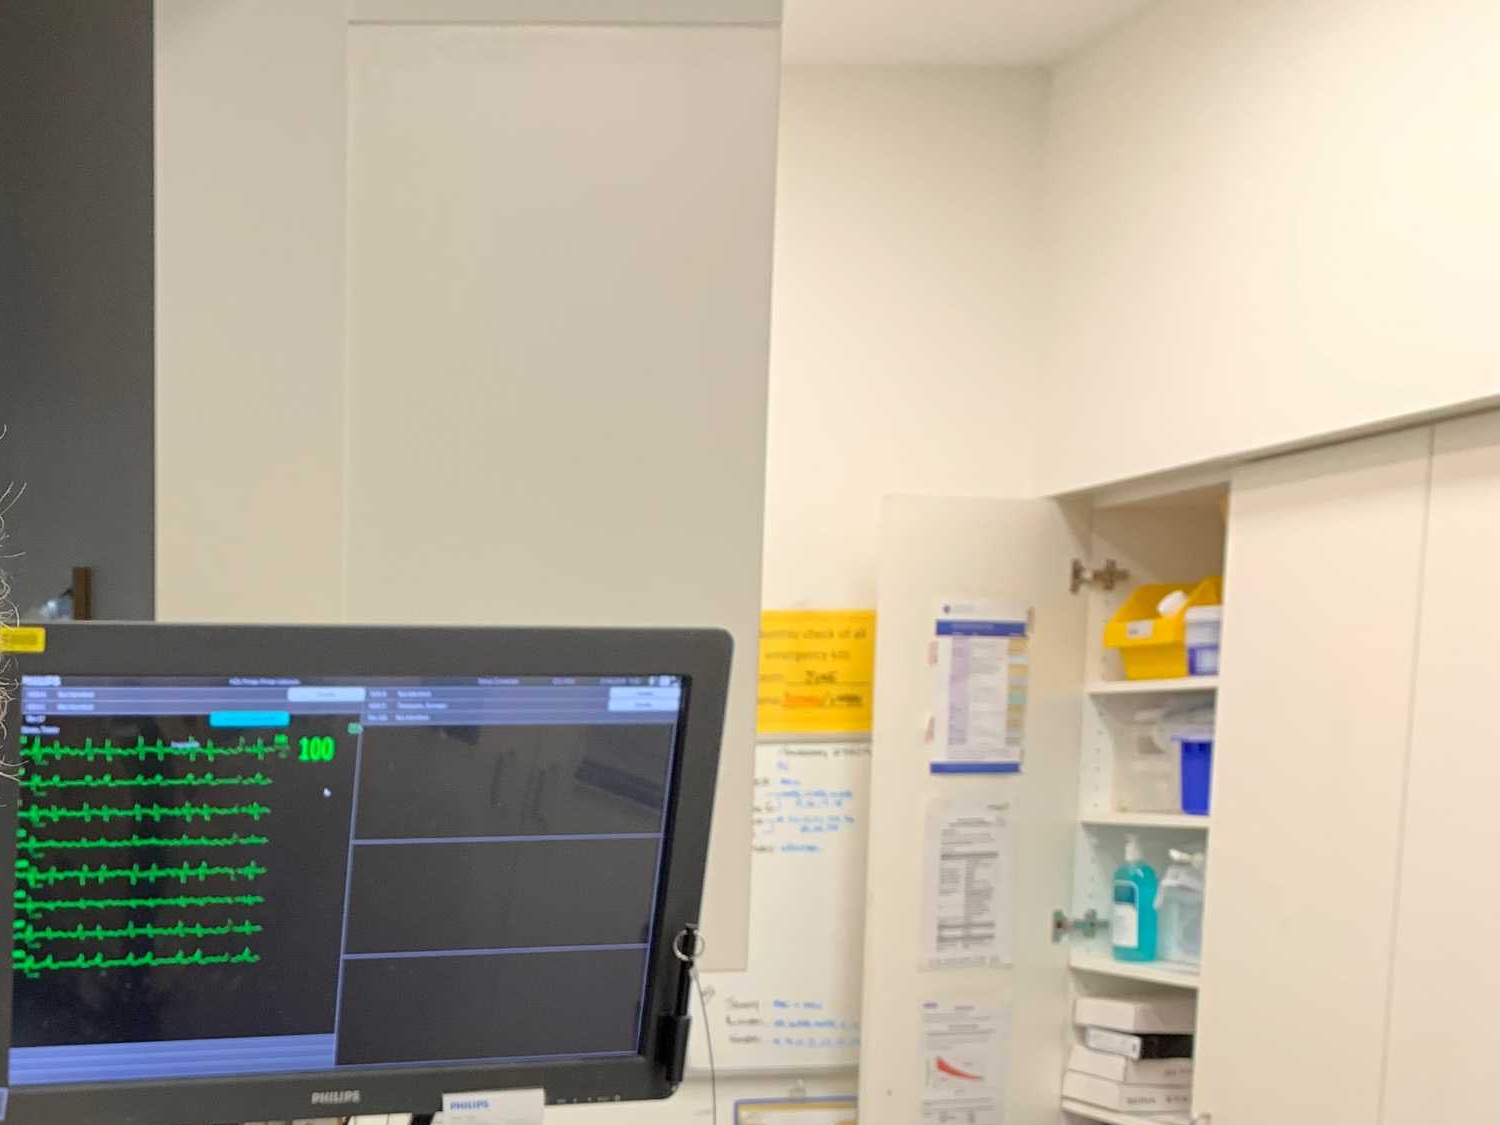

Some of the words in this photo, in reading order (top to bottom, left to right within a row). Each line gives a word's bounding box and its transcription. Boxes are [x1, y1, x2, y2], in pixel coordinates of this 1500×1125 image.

[298, 736, 335, 761] 100
[311, 1089, 361, 1105] PHILIPS
[450, 1099, 490, 1111] PHILIPS
